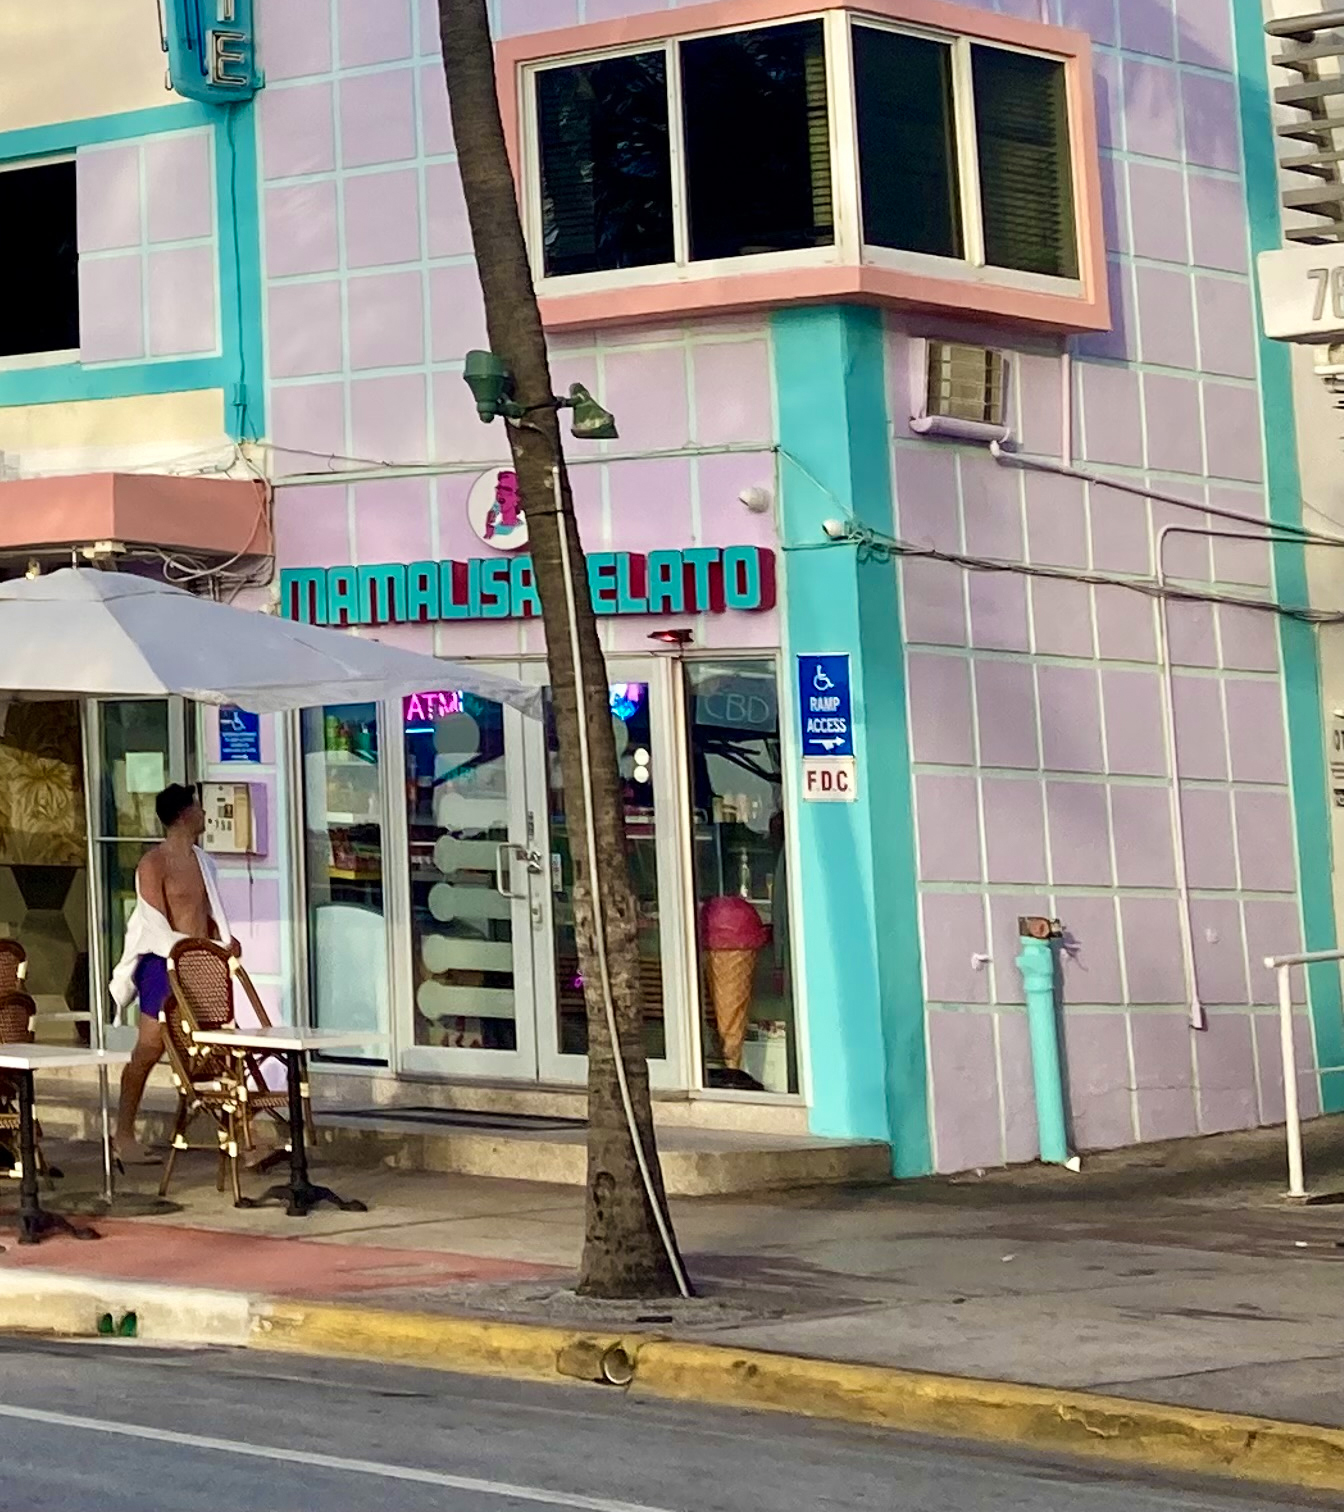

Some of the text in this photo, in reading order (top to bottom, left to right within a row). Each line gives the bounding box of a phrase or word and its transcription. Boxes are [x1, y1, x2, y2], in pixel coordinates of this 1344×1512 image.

[280, 544, 776, 626] MAMALISA ELATO
[406, 692, 459, 721] ATM
[704, 692, 770, 724] CBD
[809, 696, 842, 713] RAMP
[806, 717, 849, 734] ACCESS
